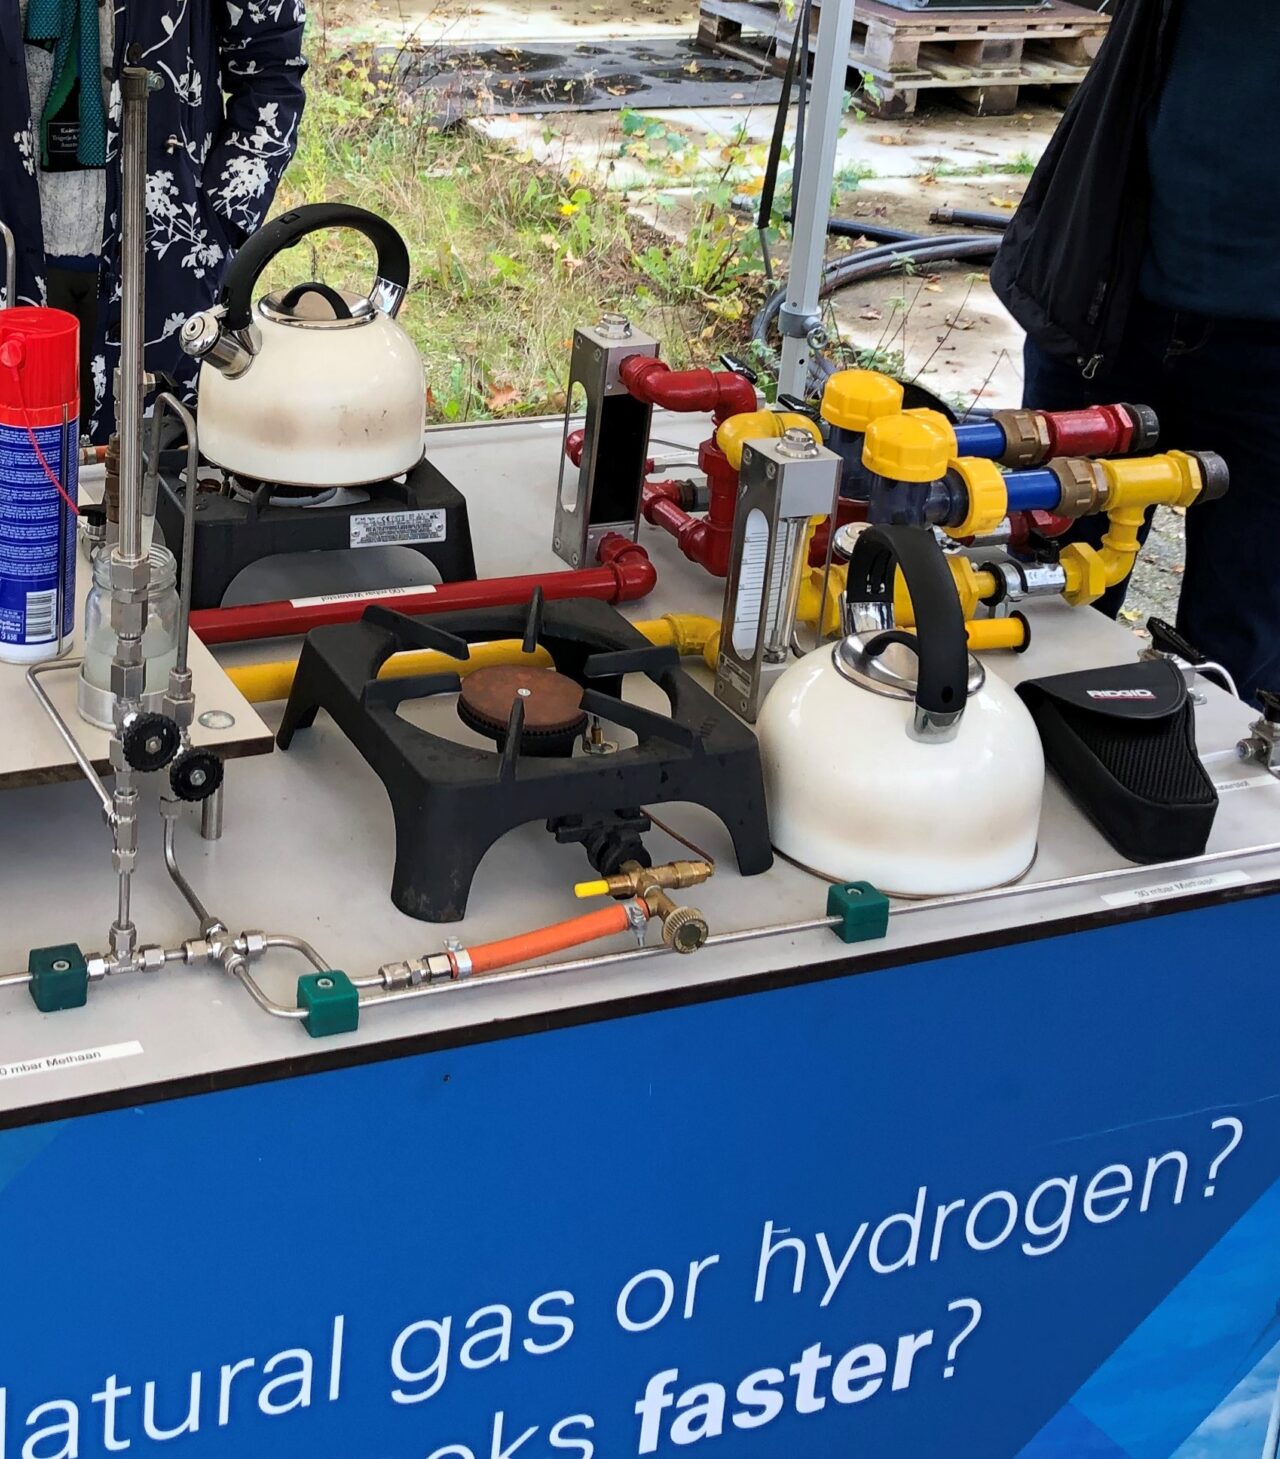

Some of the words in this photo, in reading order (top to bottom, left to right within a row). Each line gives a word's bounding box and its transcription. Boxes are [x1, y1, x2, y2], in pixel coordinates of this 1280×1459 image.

[1086, 688, 1157, 699] RIDGID
[11, 1061, 43, 1074] mbar
[46, 1050, 102, 1068] Methaan
[390, 1289, 576, 1405] gas
[615, 1253, 720, 1333] or
[753, 1116, 1245, 1308] hydrogen?
[634, 1297, 983, 1456] faster?
